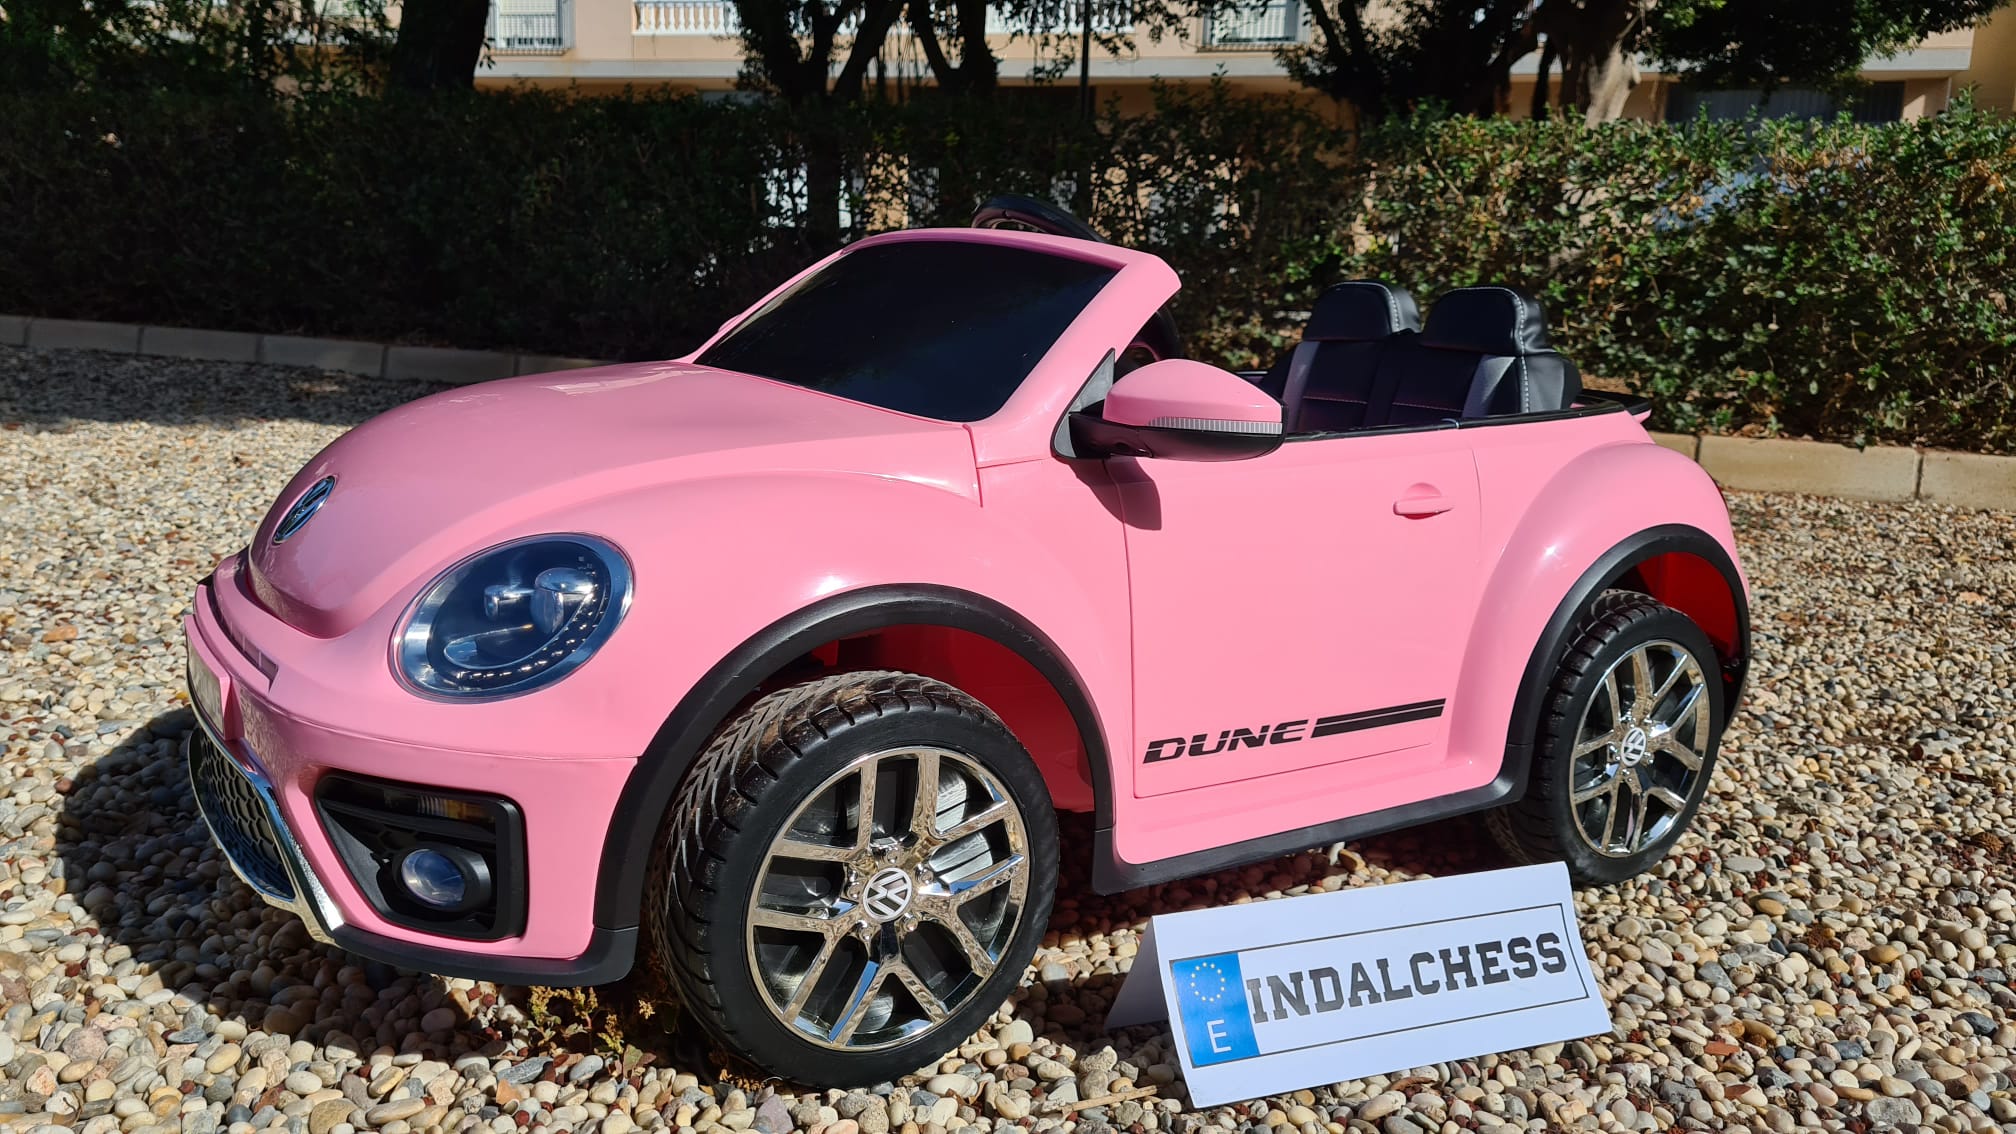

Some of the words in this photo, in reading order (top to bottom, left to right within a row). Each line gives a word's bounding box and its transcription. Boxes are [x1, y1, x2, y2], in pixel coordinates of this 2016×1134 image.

[1143, 719, 1308, 764] DUNE
[1246, 932, 1567, 1023] INDALCHESS
[1206, 1019, 1232, 1054] E
